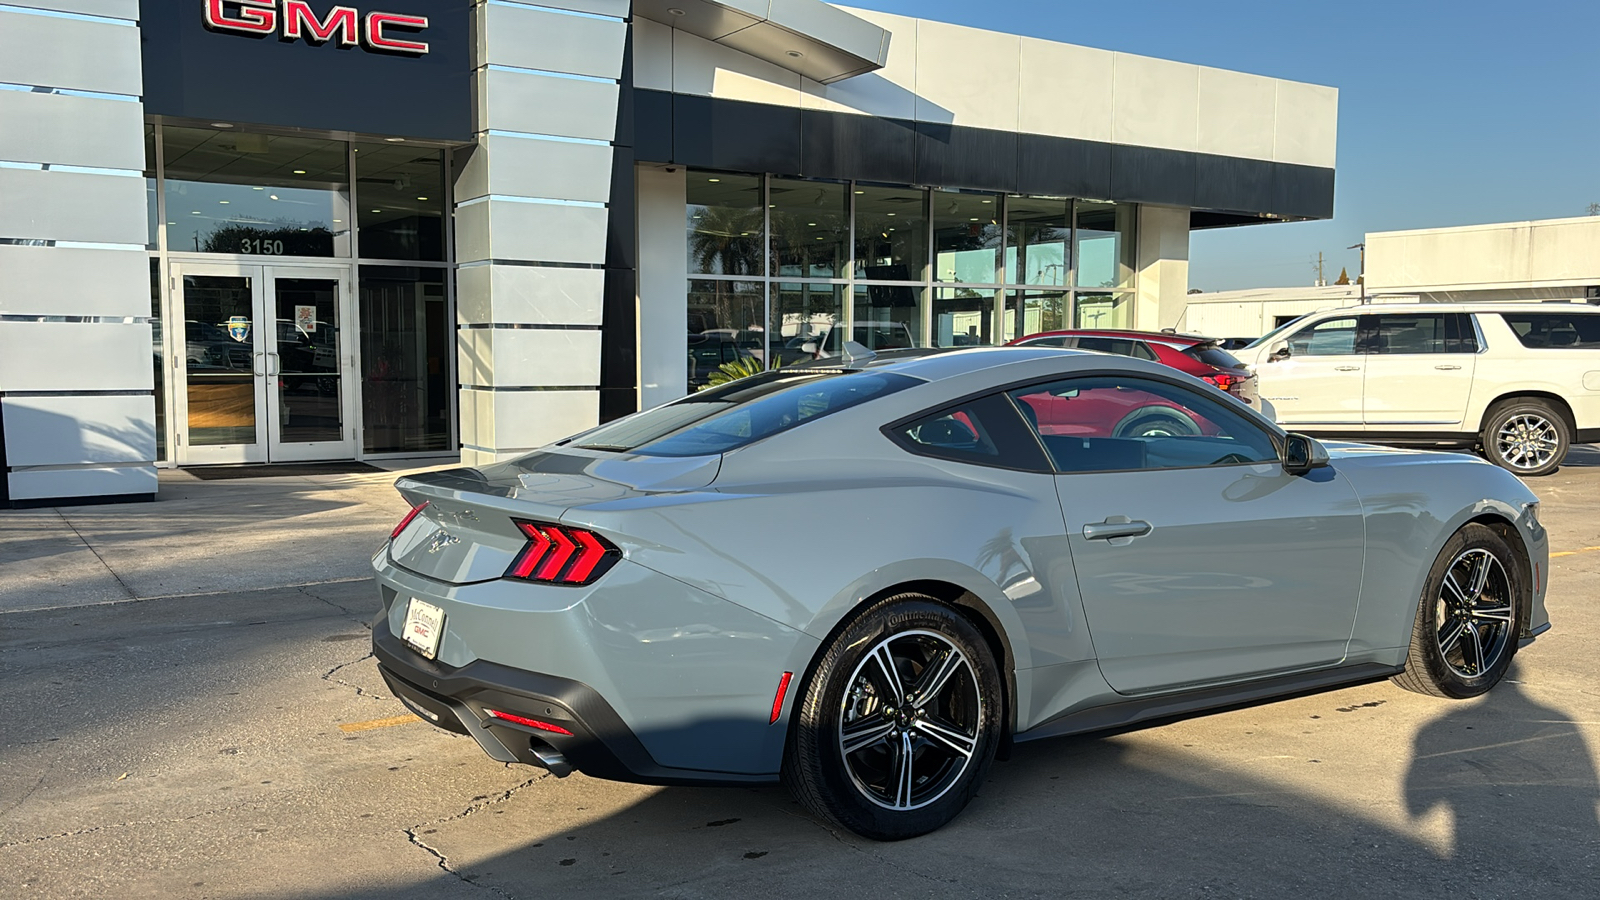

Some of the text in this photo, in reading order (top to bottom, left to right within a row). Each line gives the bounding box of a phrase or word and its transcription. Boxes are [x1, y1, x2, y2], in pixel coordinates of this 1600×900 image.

[205, 0, 429, 53] GMC
[241, 238, 284, 255] 3150
[414, 625, 430, 638] GMC
